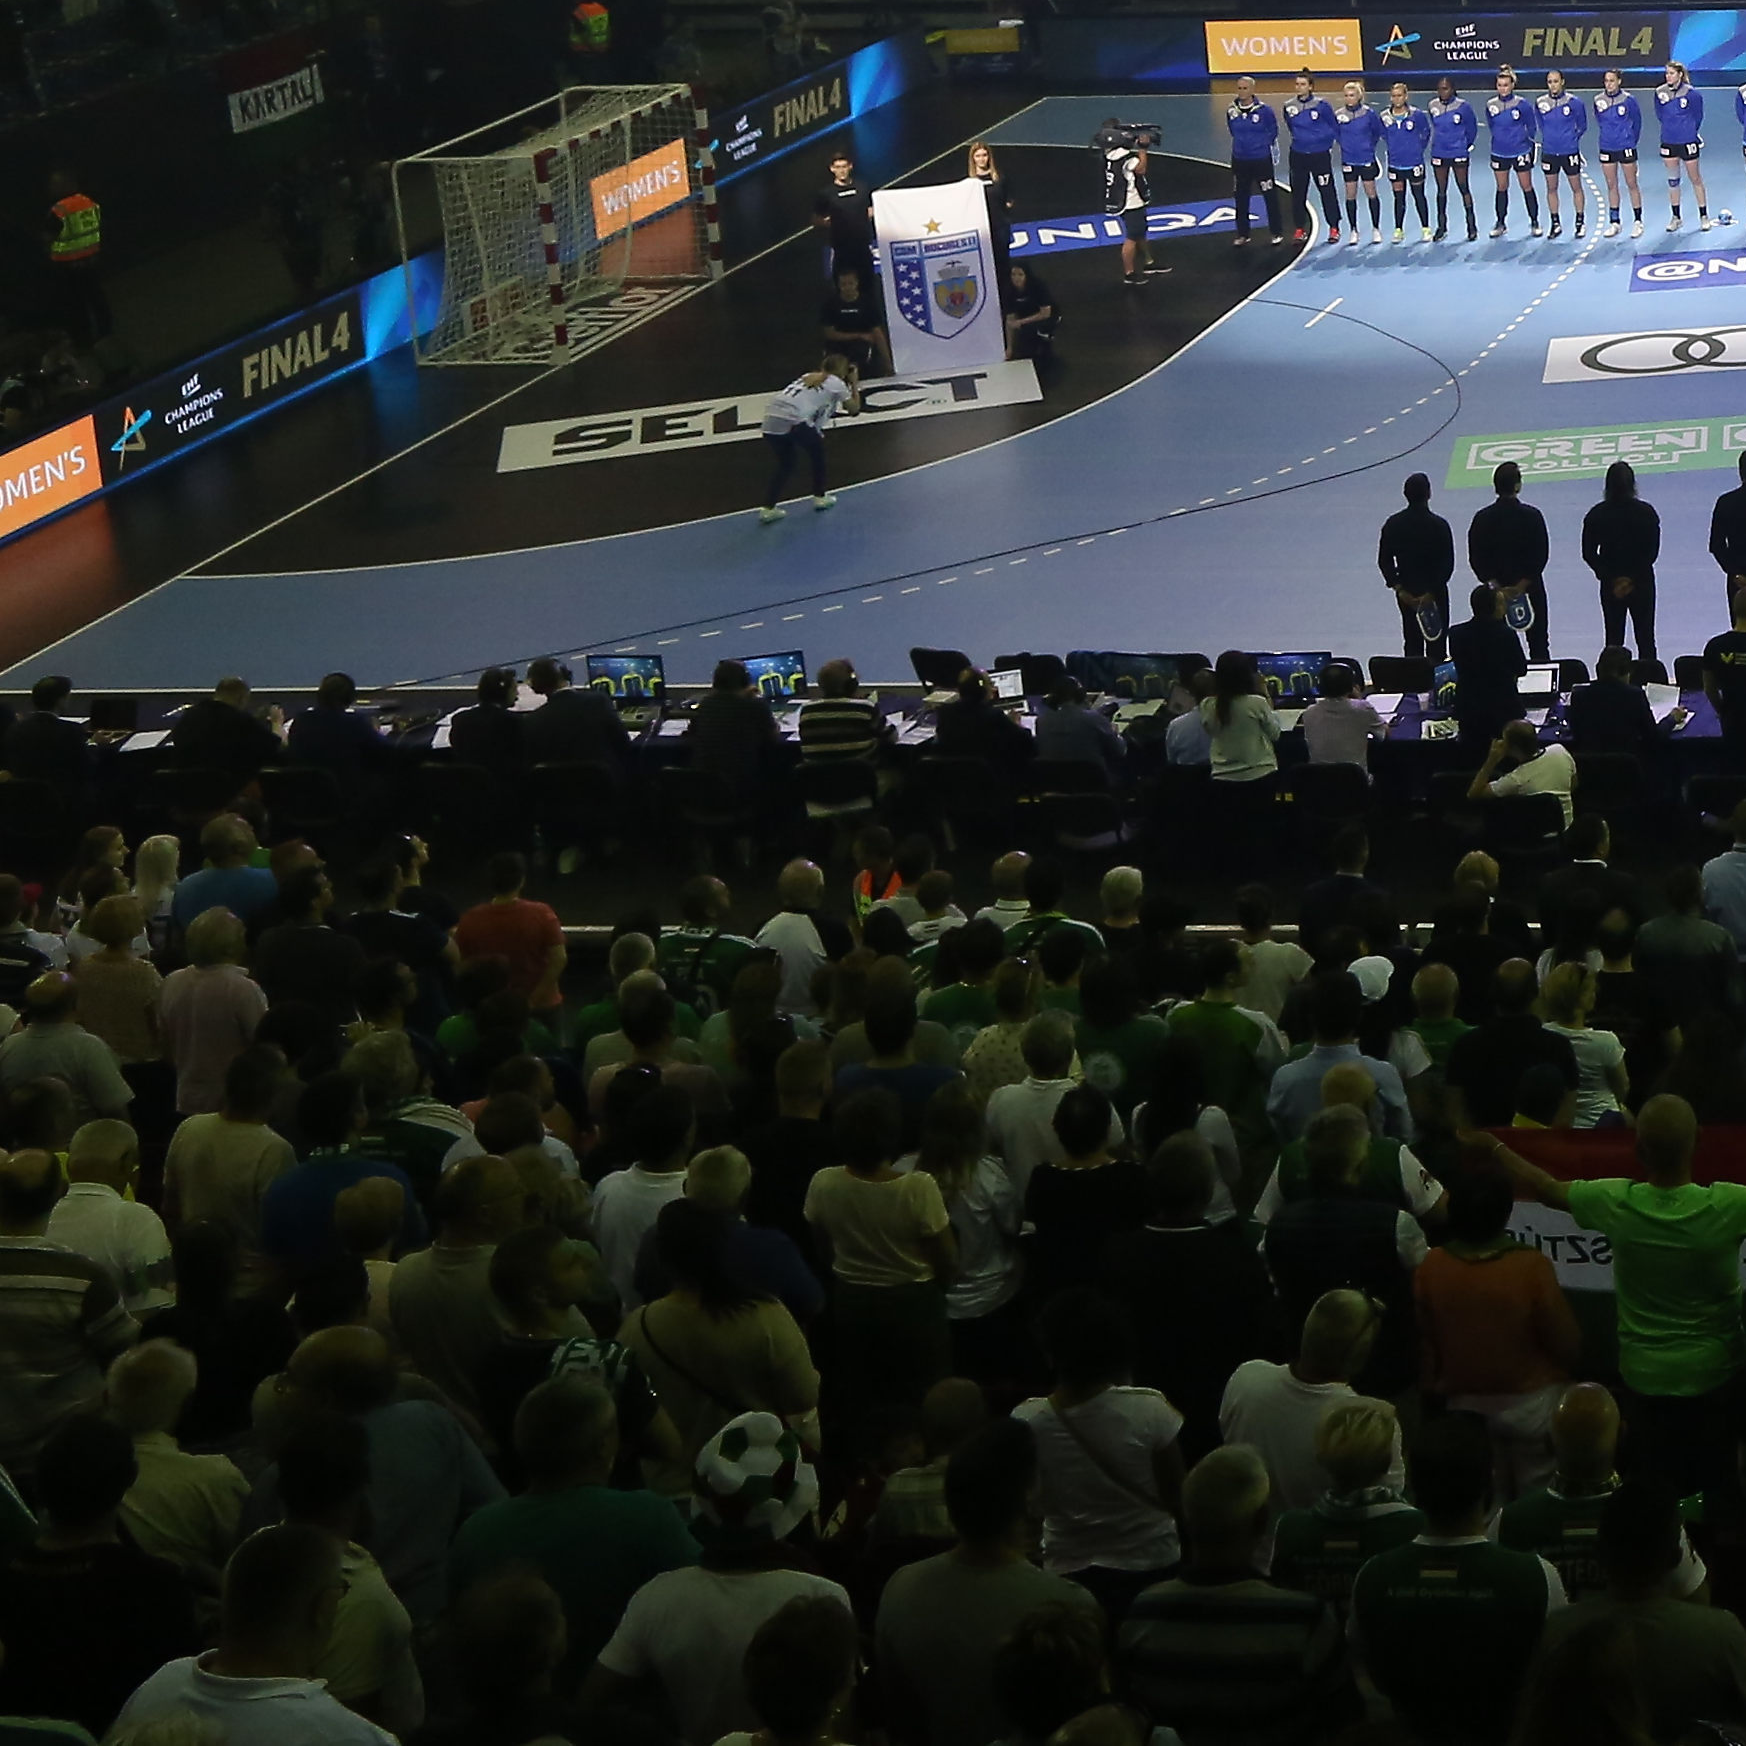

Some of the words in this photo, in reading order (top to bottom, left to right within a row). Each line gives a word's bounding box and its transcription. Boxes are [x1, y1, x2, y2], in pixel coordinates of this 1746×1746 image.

[1220, 34, 1349, 57] WOMEN'S
[1433, 40, 1500, 52] CHAMPIONS
[1446, 51, 1489, 61] LEAGUE
[164, 386, 225, 425] CHAMPIONS
[176, 406, 215, 434] LEAGUE
[1479, 428, 1702, 465] GREEN
